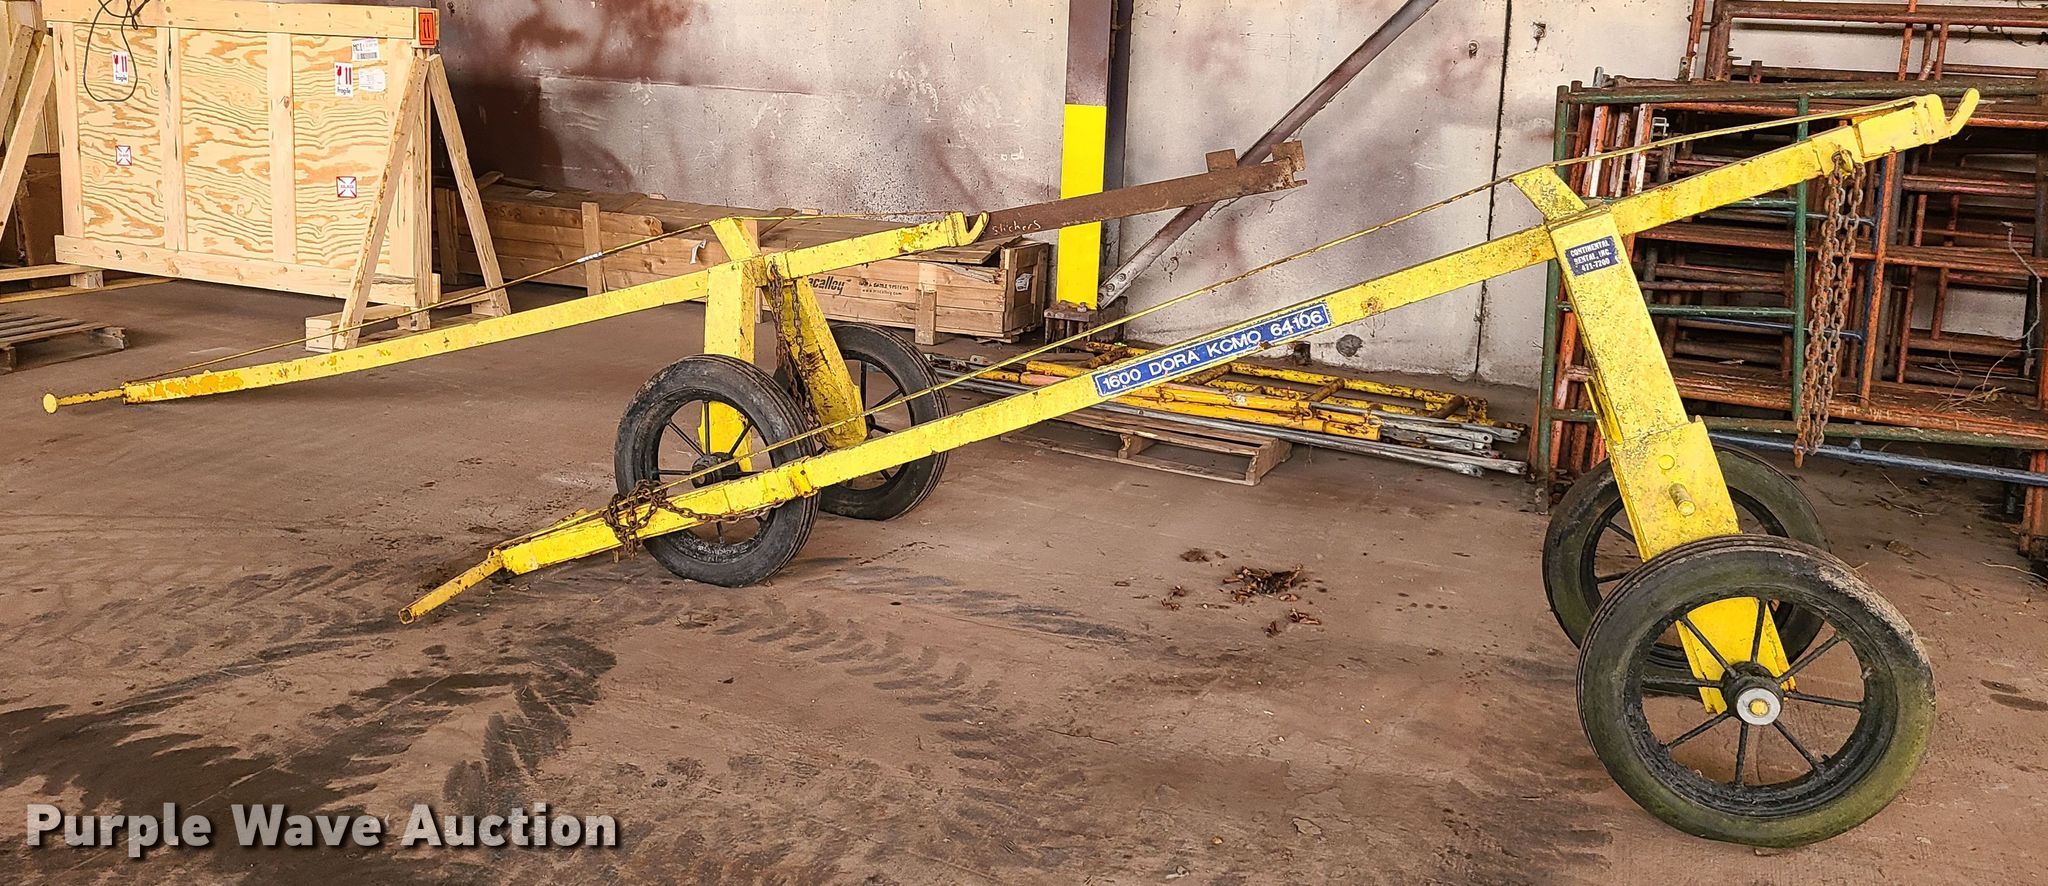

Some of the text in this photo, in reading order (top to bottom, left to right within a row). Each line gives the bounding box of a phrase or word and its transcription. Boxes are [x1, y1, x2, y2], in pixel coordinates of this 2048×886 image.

[1570, 240, 1610, 257] CONTINENTAL
[808, 275, 845, 296] acalloy
[1102, 310, 1323, 390] 1600 DORA KCMO 64106
